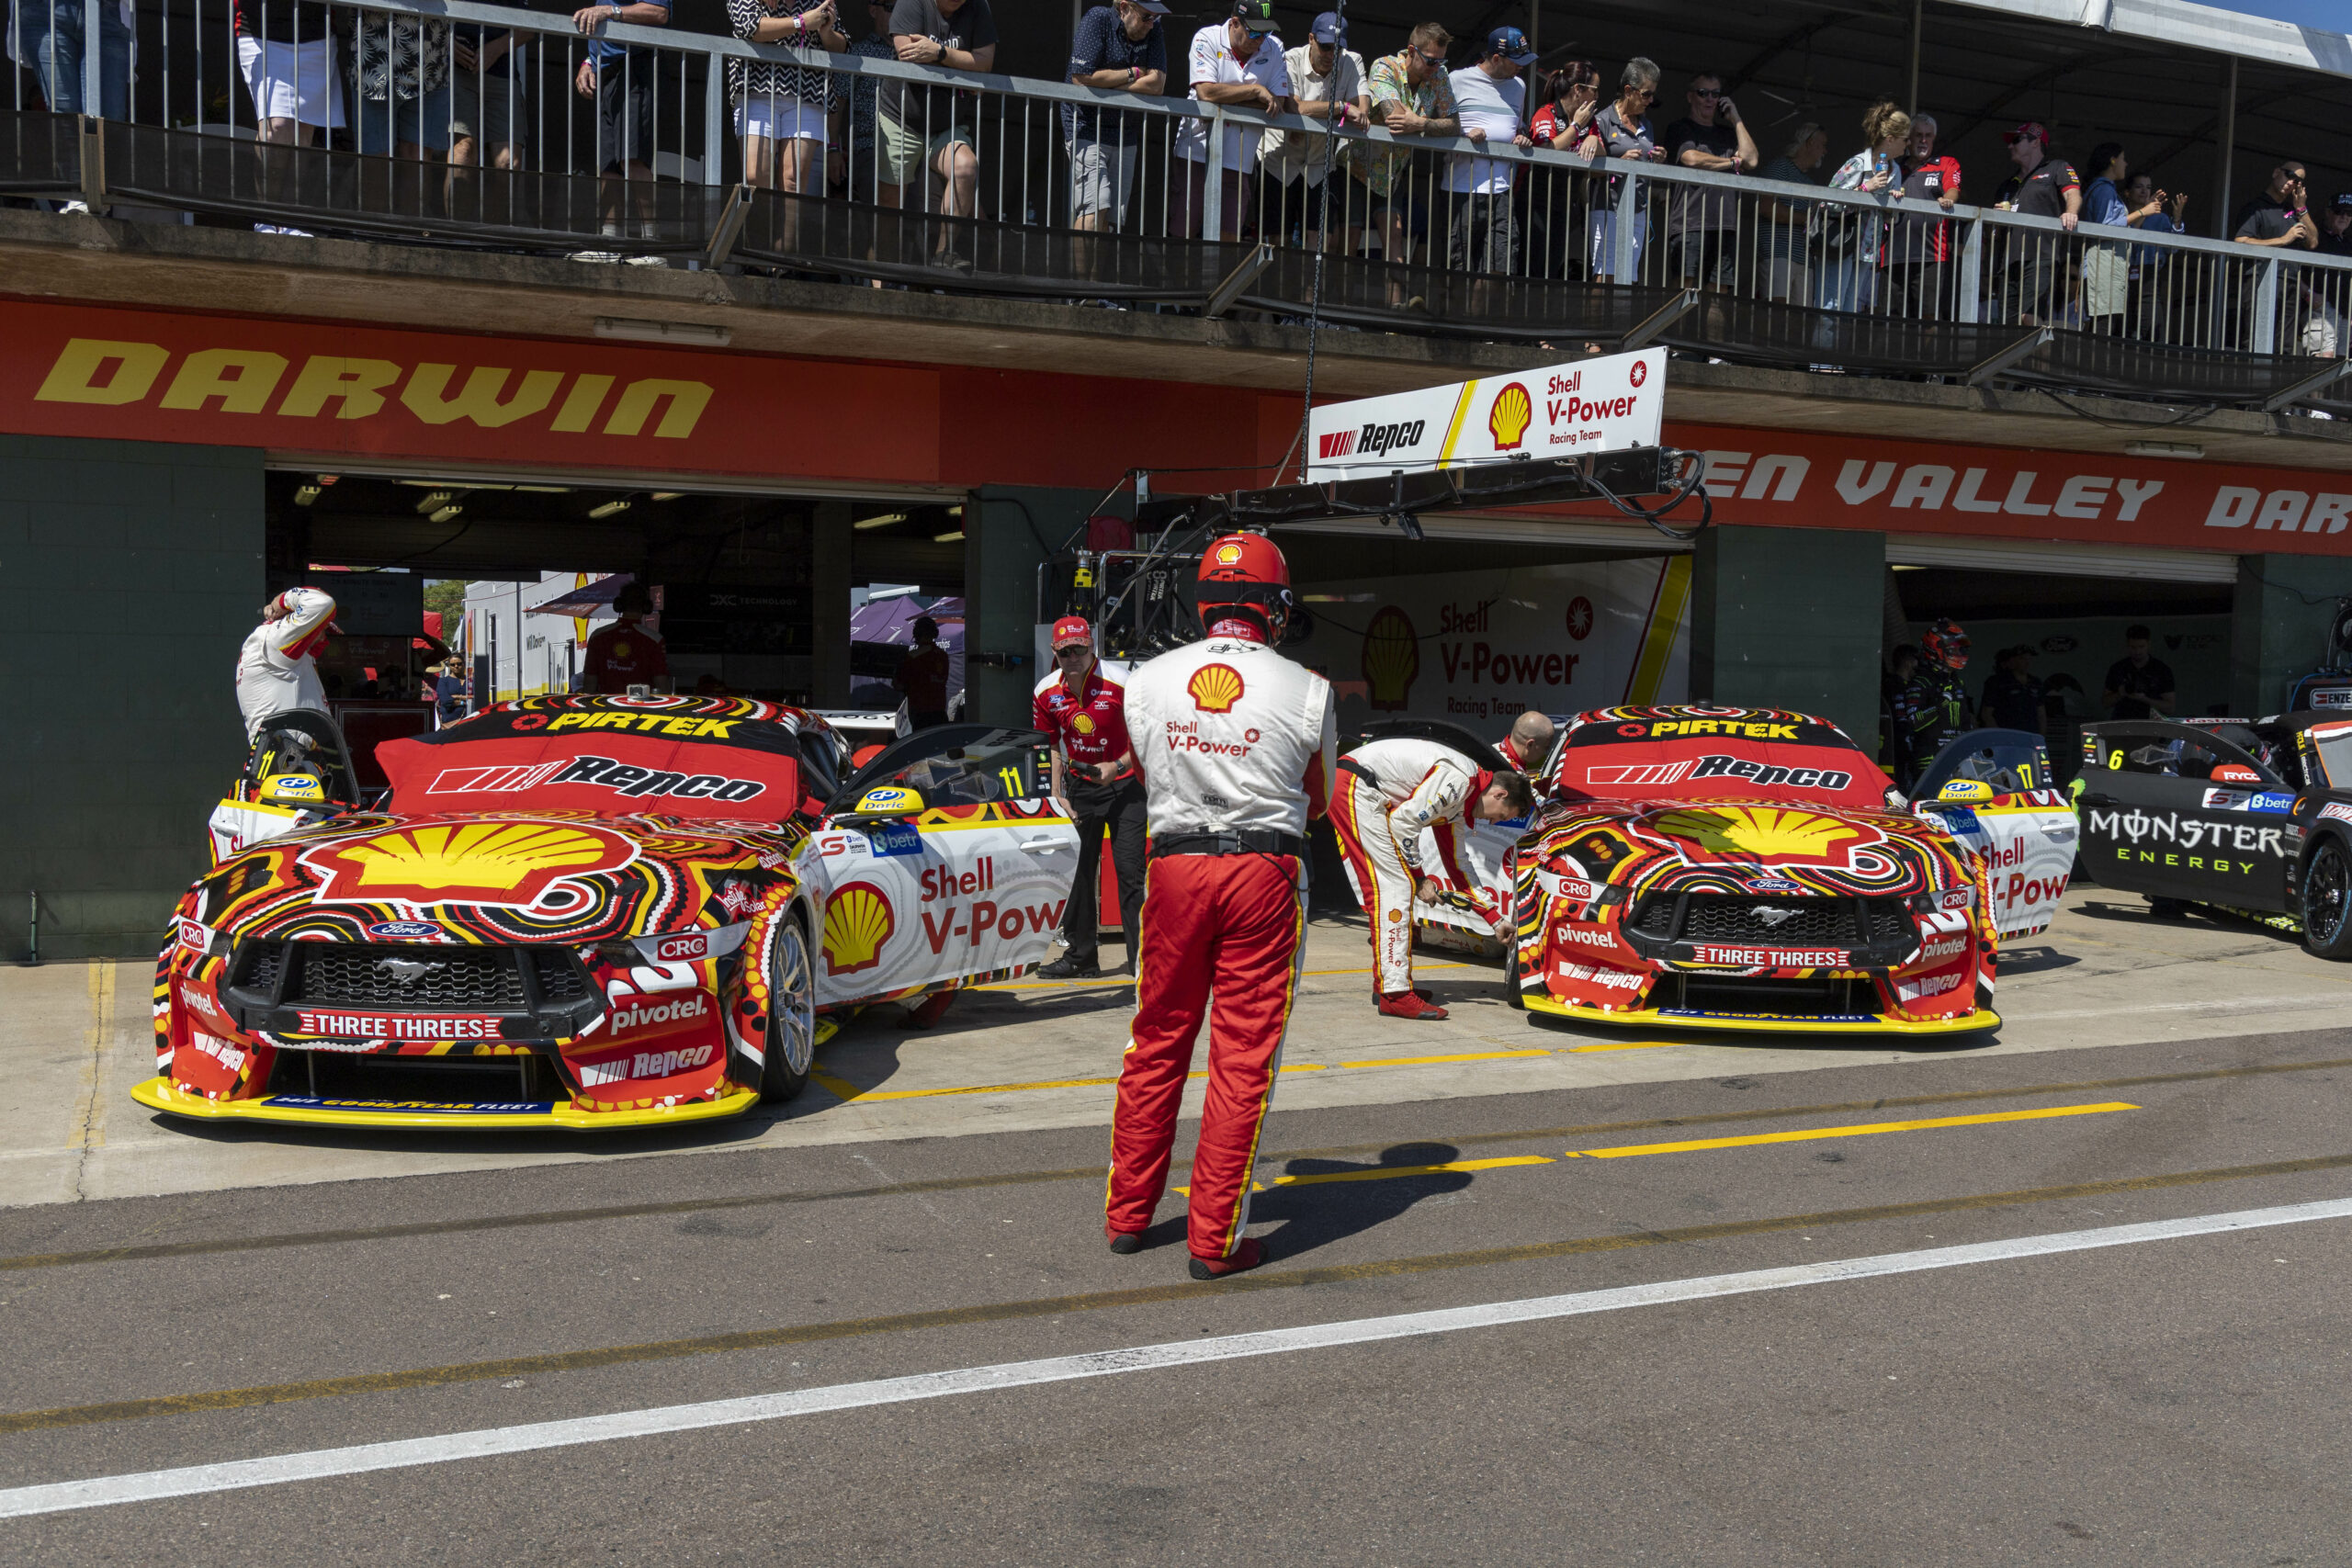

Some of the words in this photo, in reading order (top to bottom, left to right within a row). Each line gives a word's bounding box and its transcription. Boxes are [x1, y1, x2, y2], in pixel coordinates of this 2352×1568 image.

[1924, 176, 1939, 186] 05
[33, 337, 715, 439] DARWIN
[1547, 371, 1581, 396] Shell
[1546, 394, 1637, 426] V-Power
[1357, 419, 1425, 457] Repco
[1549, 430, 1577, 446] Racing
[1579, 429, 1602, 442] Team
[1834, 459, 2165, 522] VALLEY
[1441, 601, 1488, 633] Shell
[1441, 642, 1580, 686] V-Power
[1447, 696, 1487, 719] Racing
[1491, 696, 1526, 715] Team
[546, 711, 742, 739] PIRTEK
[1166, 721, 1197, 734] Shell
[1650, 720, 1800, 739] PIRTEK
[1167, 735, 1251, 758] V-Power
[257, 750, 276, 781] 11
[2109, 749, 2124, 770] 6
[548, 755, 766, 803] Repco
[999, 766, 1024, 797] 11
[1687, 754, 1853, 791] Repco
[2016, 763, 2034, 789] 17
[274, 788, 316, 798] Doric
[864, 801, 905, 809] Doric
[2265, 796, 2292, 809] betr
[1957, 817, 1976, 829] betr
[2089, 808, 2285, 858] MONSTER
[888, 833, 917, 849] betr
[1980, 836, 2024, 870] Shell
[2117, 848, 2255, 874] ENERGY
[921, 856, 993, 902] Shell
[1560, 880, 1590, 897] CRC
[1757, 879, 1791, 890] Ford
[743, 899, 766, 913] Solar
[1943, 891, 1967, 908] CRC
[182, 923, 204, 947] CRC
[379, 922, 428, 938] Ford
[659, 937, 706, 958] CRC
[1387, 928, 1396, 964] V-Power
[1707, 947, 1766, 964] THREE
[1771, 951, 1837, 966] THREES
[1592, 966, 1644, 990] Repco
[1919, 973, 1962, 997] Repco
[315, 1014, 387, 1037] THREE
[391, 1018, 484, 1039] THREES
[1703, 1010, 1820, 1020] GOODYEAR
[632, 1044, 713, 1079] Repco
[322, 1100, 475, 1110] GOODYEAR
